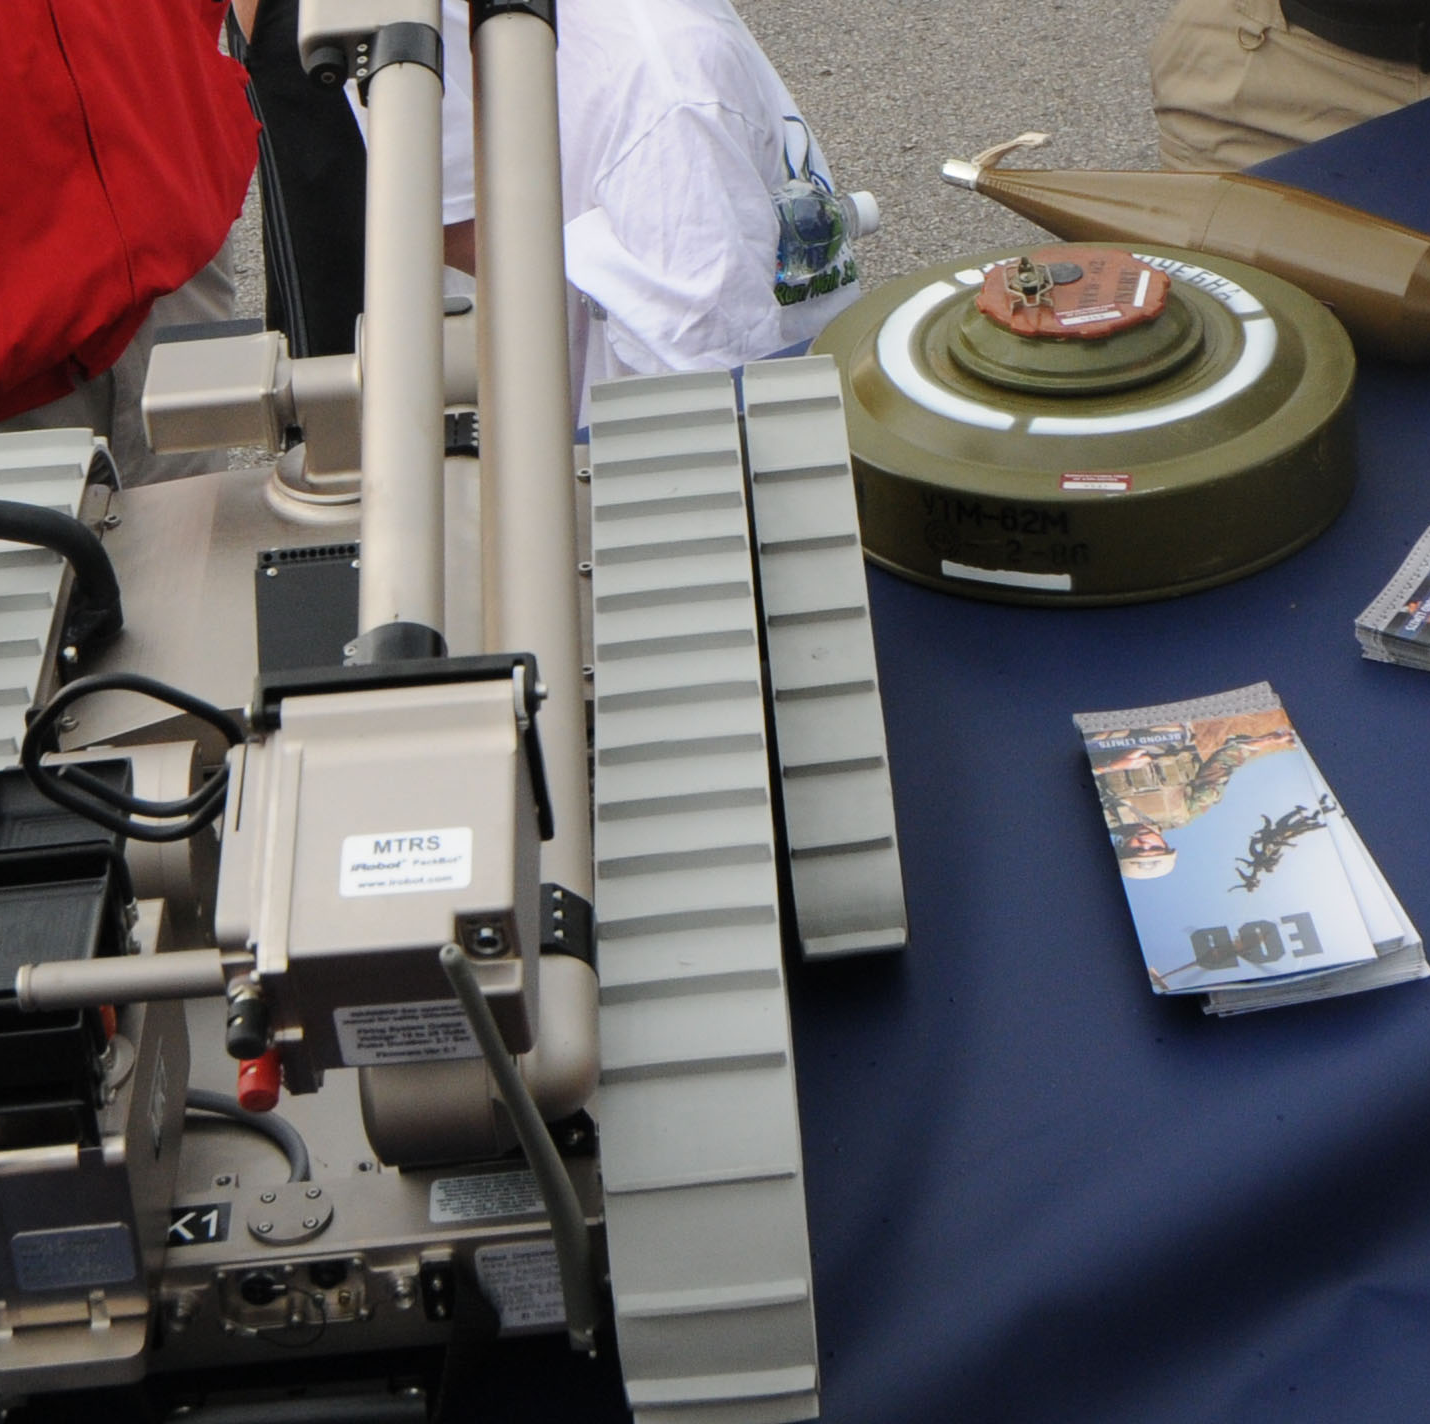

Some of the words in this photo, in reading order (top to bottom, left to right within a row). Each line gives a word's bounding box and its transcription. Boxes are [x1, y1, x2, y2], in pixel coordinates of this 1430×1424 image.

[1098, 738, 1137, 750] LIMITS
[1137, 731, 1182, 746] BEYOND
[373, 835, 441, 854] MTRS
